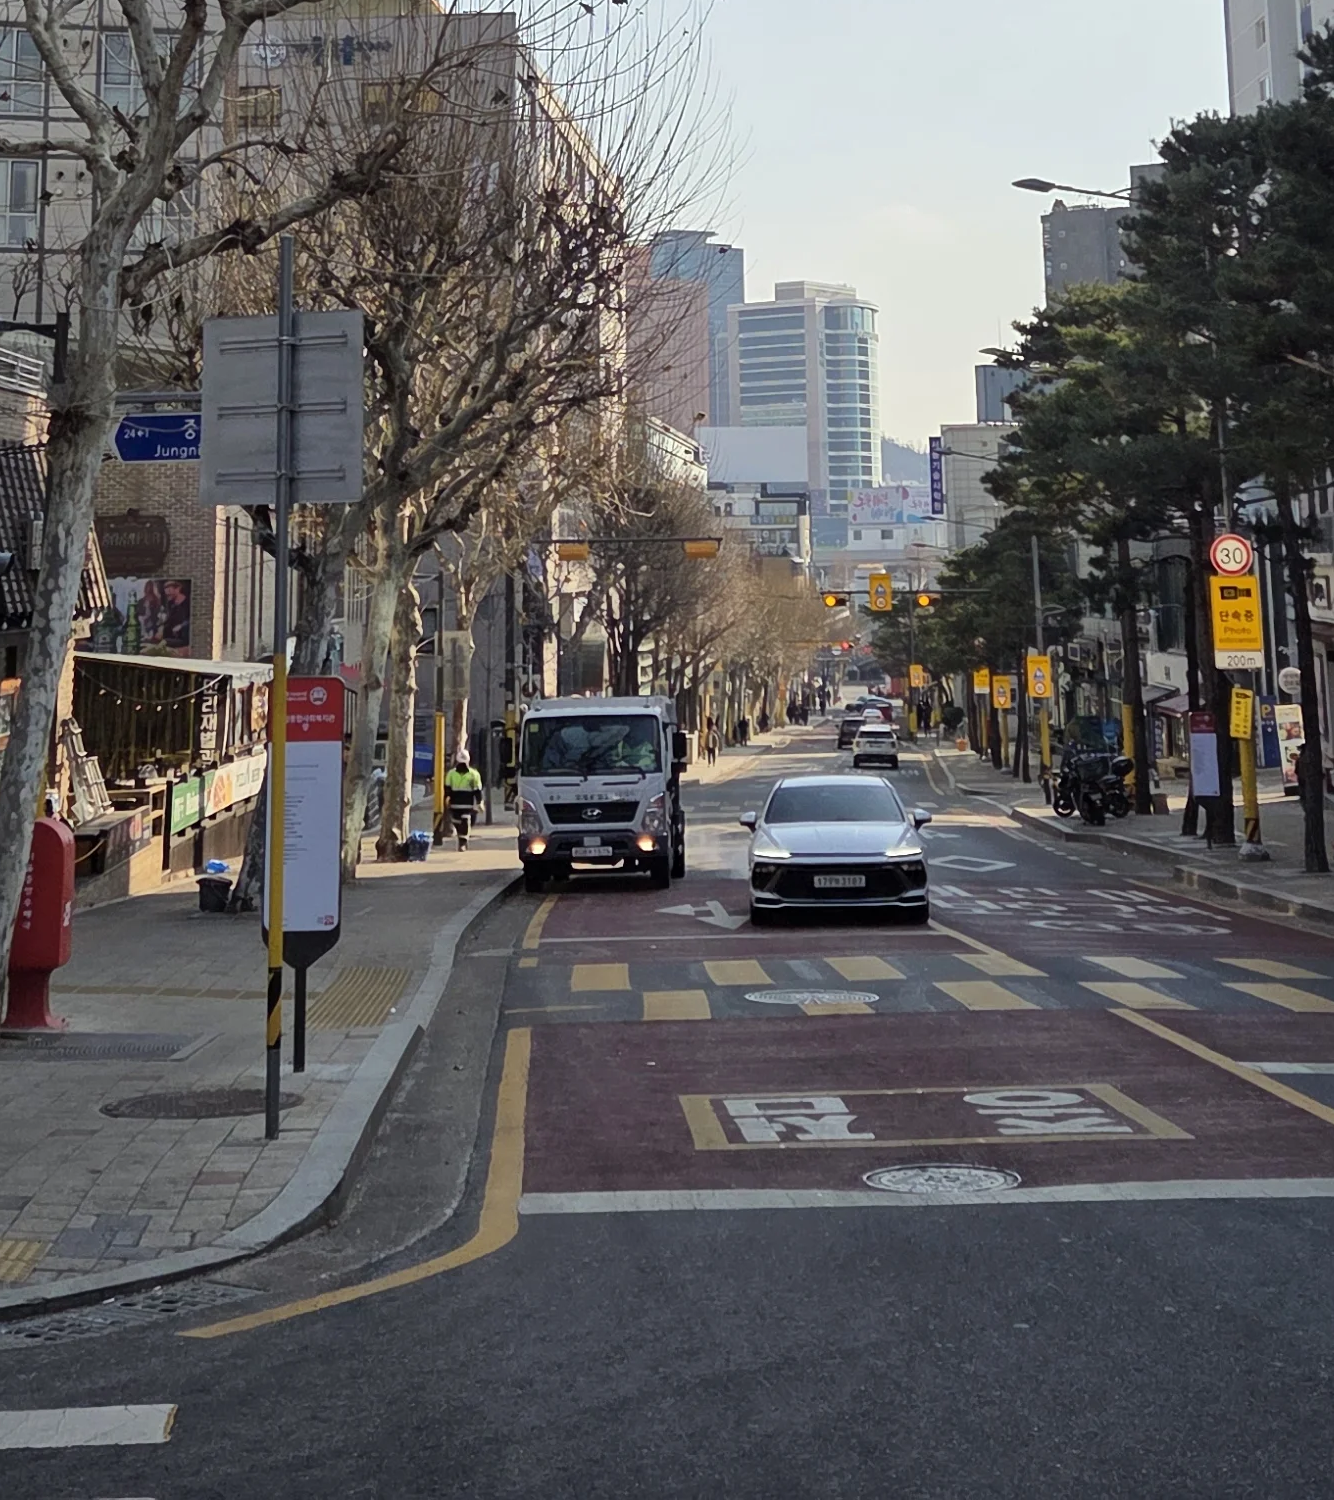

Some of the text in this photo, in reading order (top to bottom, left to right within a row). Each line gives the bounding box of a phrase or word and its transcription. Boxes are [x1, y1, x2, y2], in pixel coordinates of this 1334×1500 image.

[1220, 548, 1244, 564] 30
[1219, 609, 1254, 622] 단속중
[1227, 655, 1256, 667] 200m
